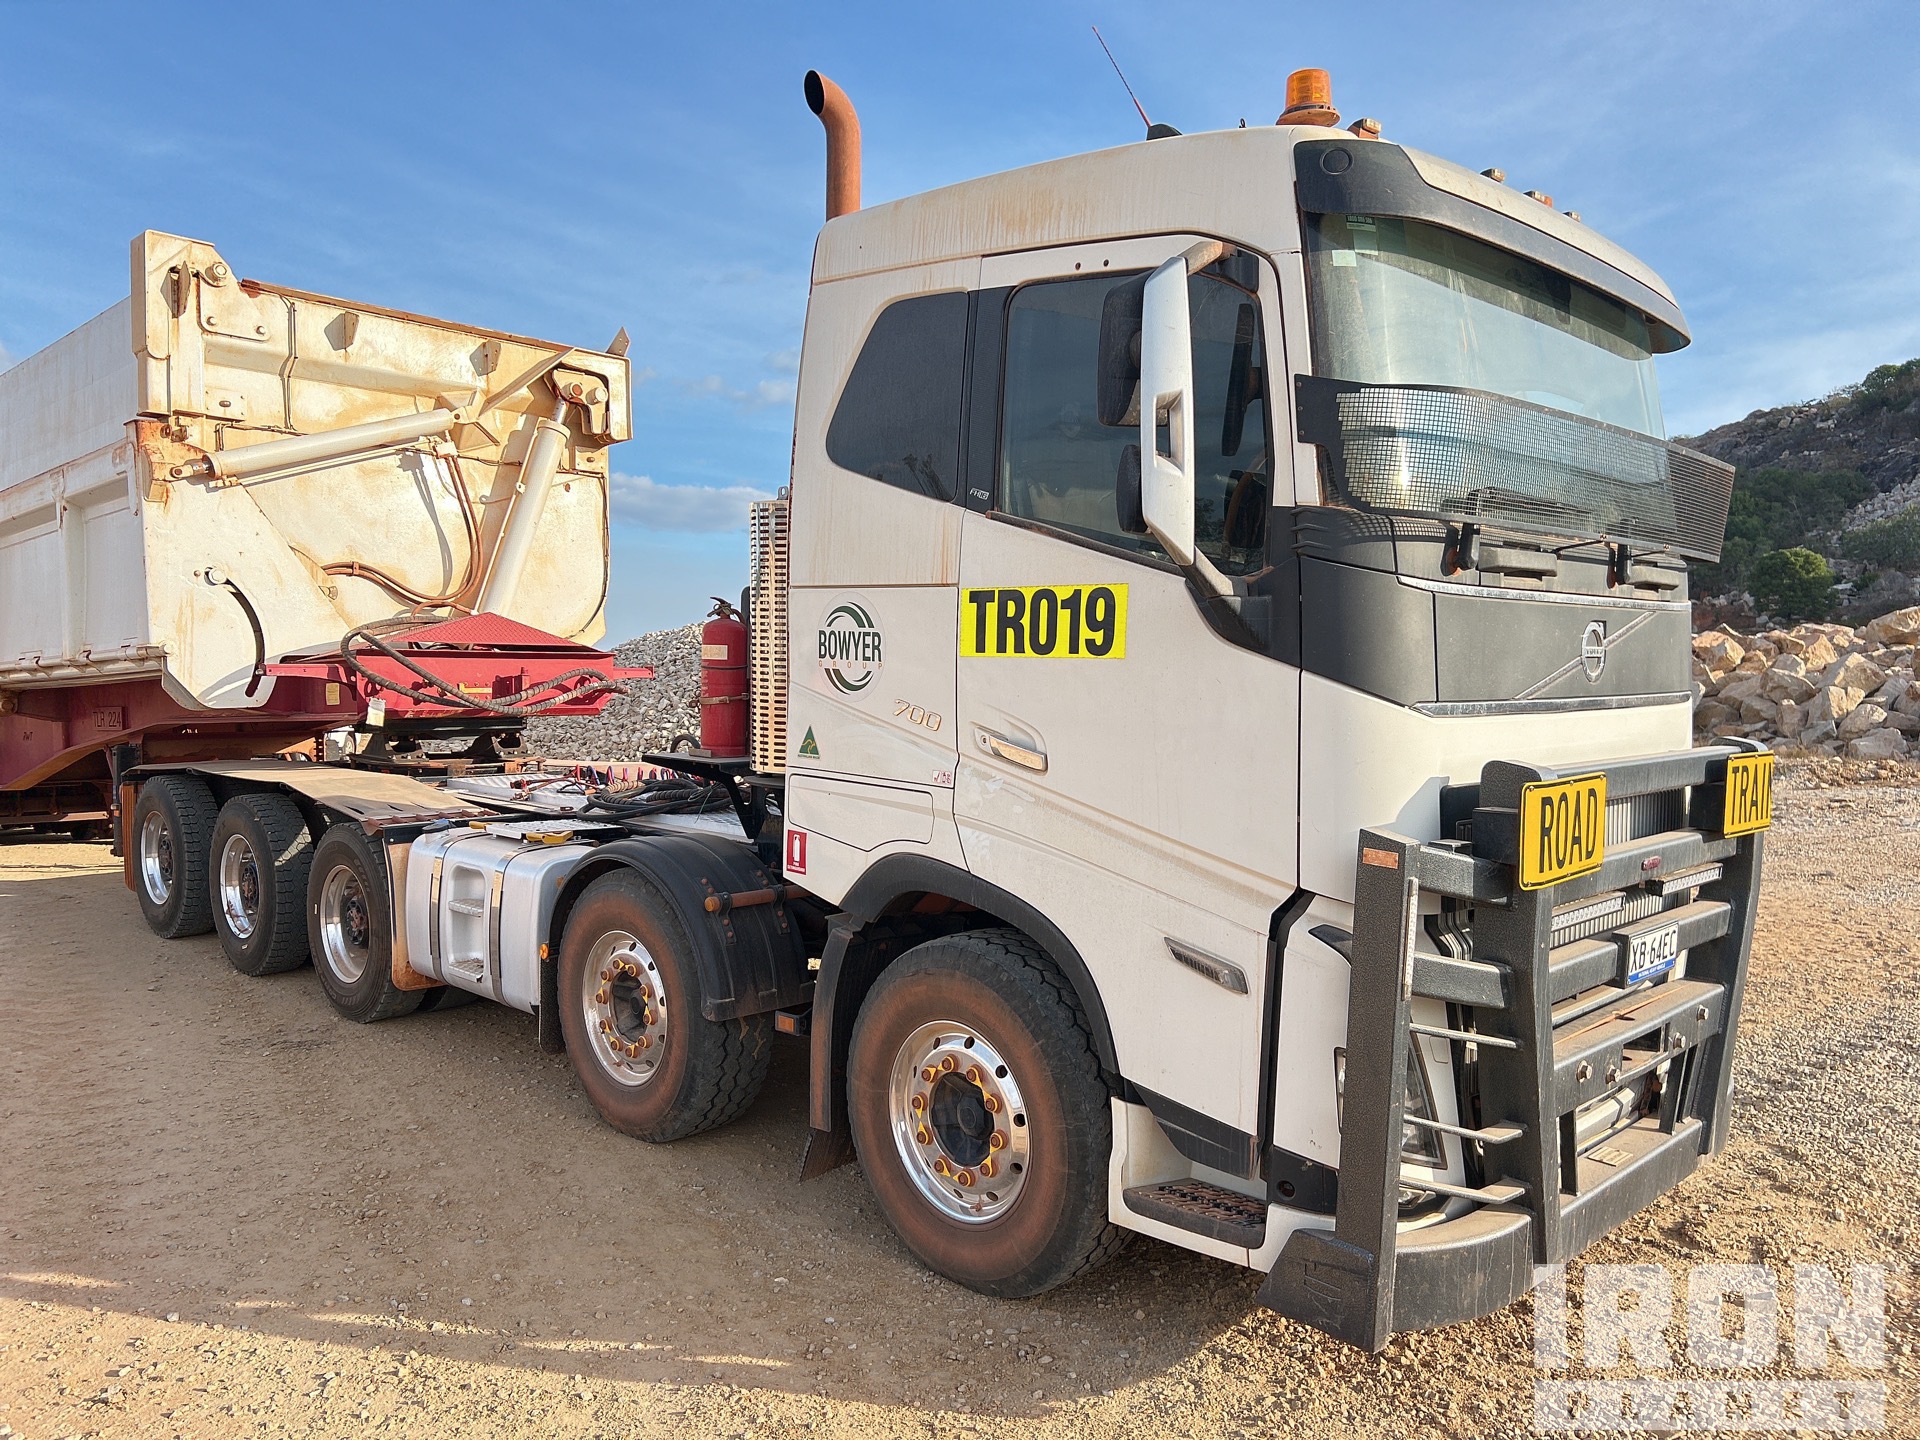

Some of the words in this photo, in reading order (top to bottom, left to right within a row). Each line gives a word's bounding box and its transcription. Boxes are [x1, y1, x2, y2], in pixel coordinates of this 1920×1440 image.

[968, 586, 1117, 656] TR019
[818, 629, 882, 662] BOWYER
[818, 660, 883, 670] GROUP
[108, 711, 121, 728] 224
[892, 698, 942, 732] 700
[1538, 786, 1598, 874] ROAD
